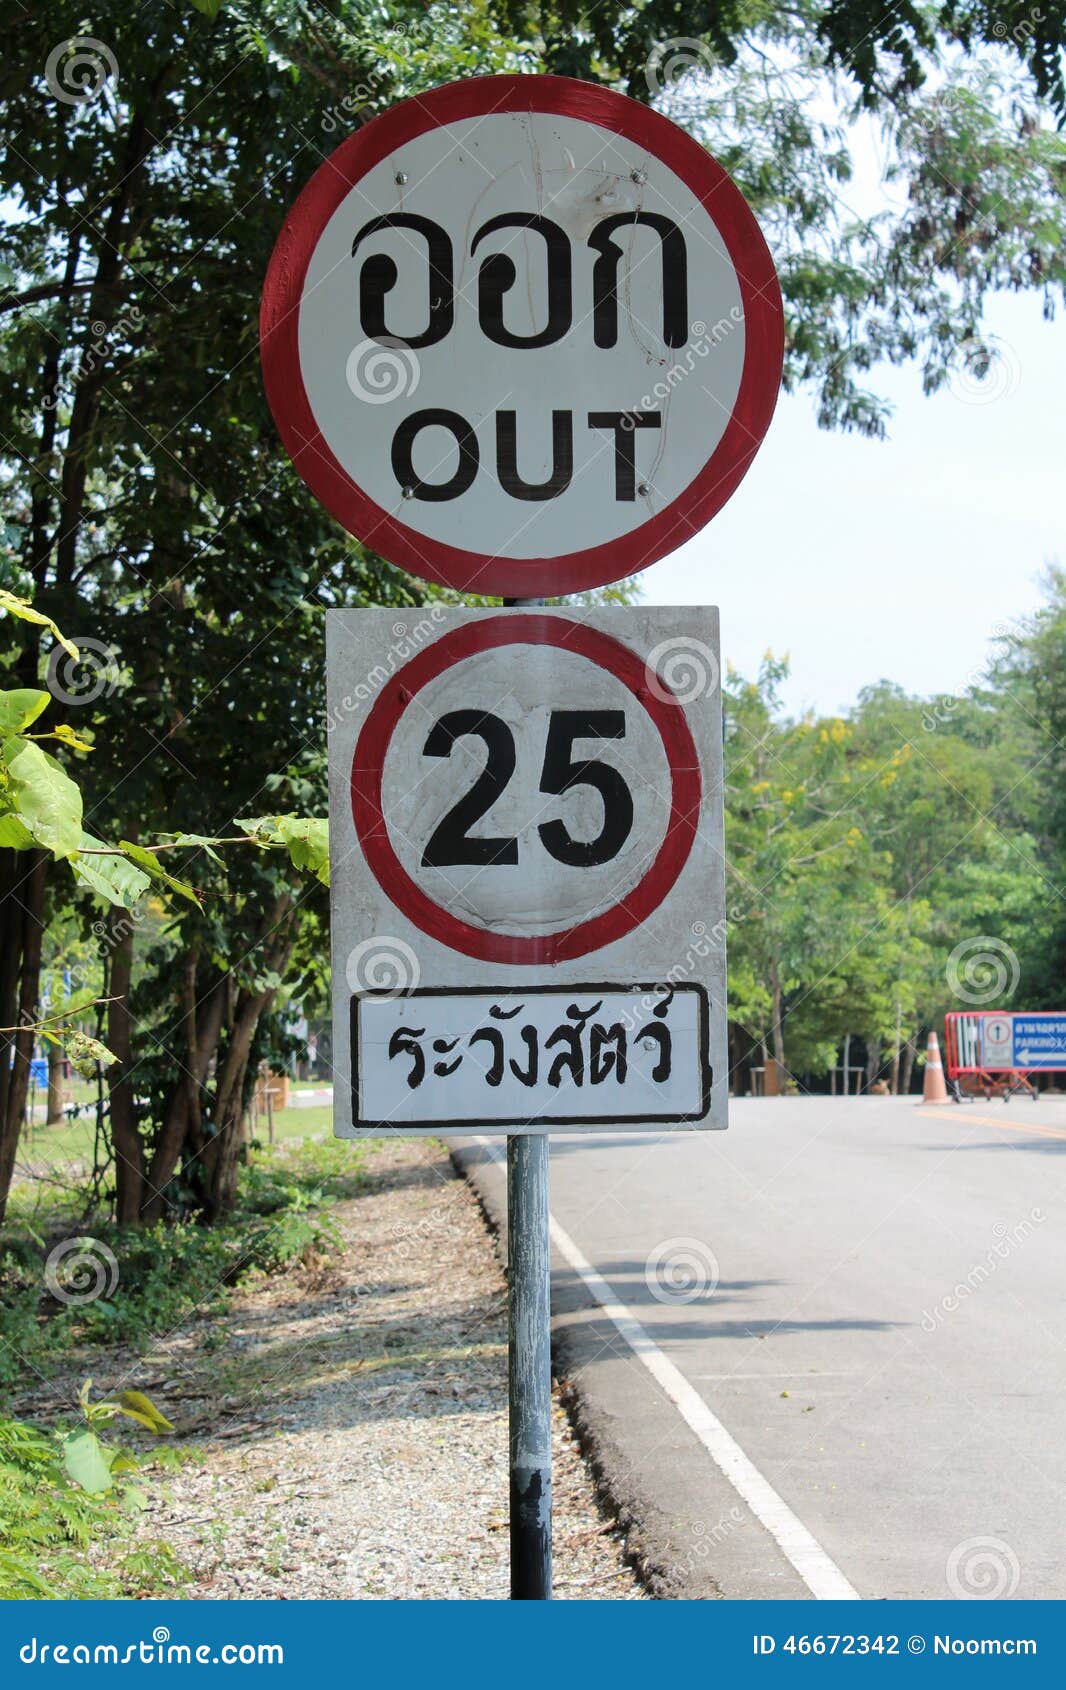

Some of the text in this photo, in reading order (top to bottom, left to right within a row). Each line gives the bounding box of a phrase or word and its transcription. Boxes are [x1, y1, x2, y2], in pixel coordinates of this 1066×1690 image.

[351, 211, 688, 349] ออก
[391, 407, 662, 502] OUT
[421, 708, 634, 868] 25
[388, 991, 675, 1089] ระวังสัตว์
